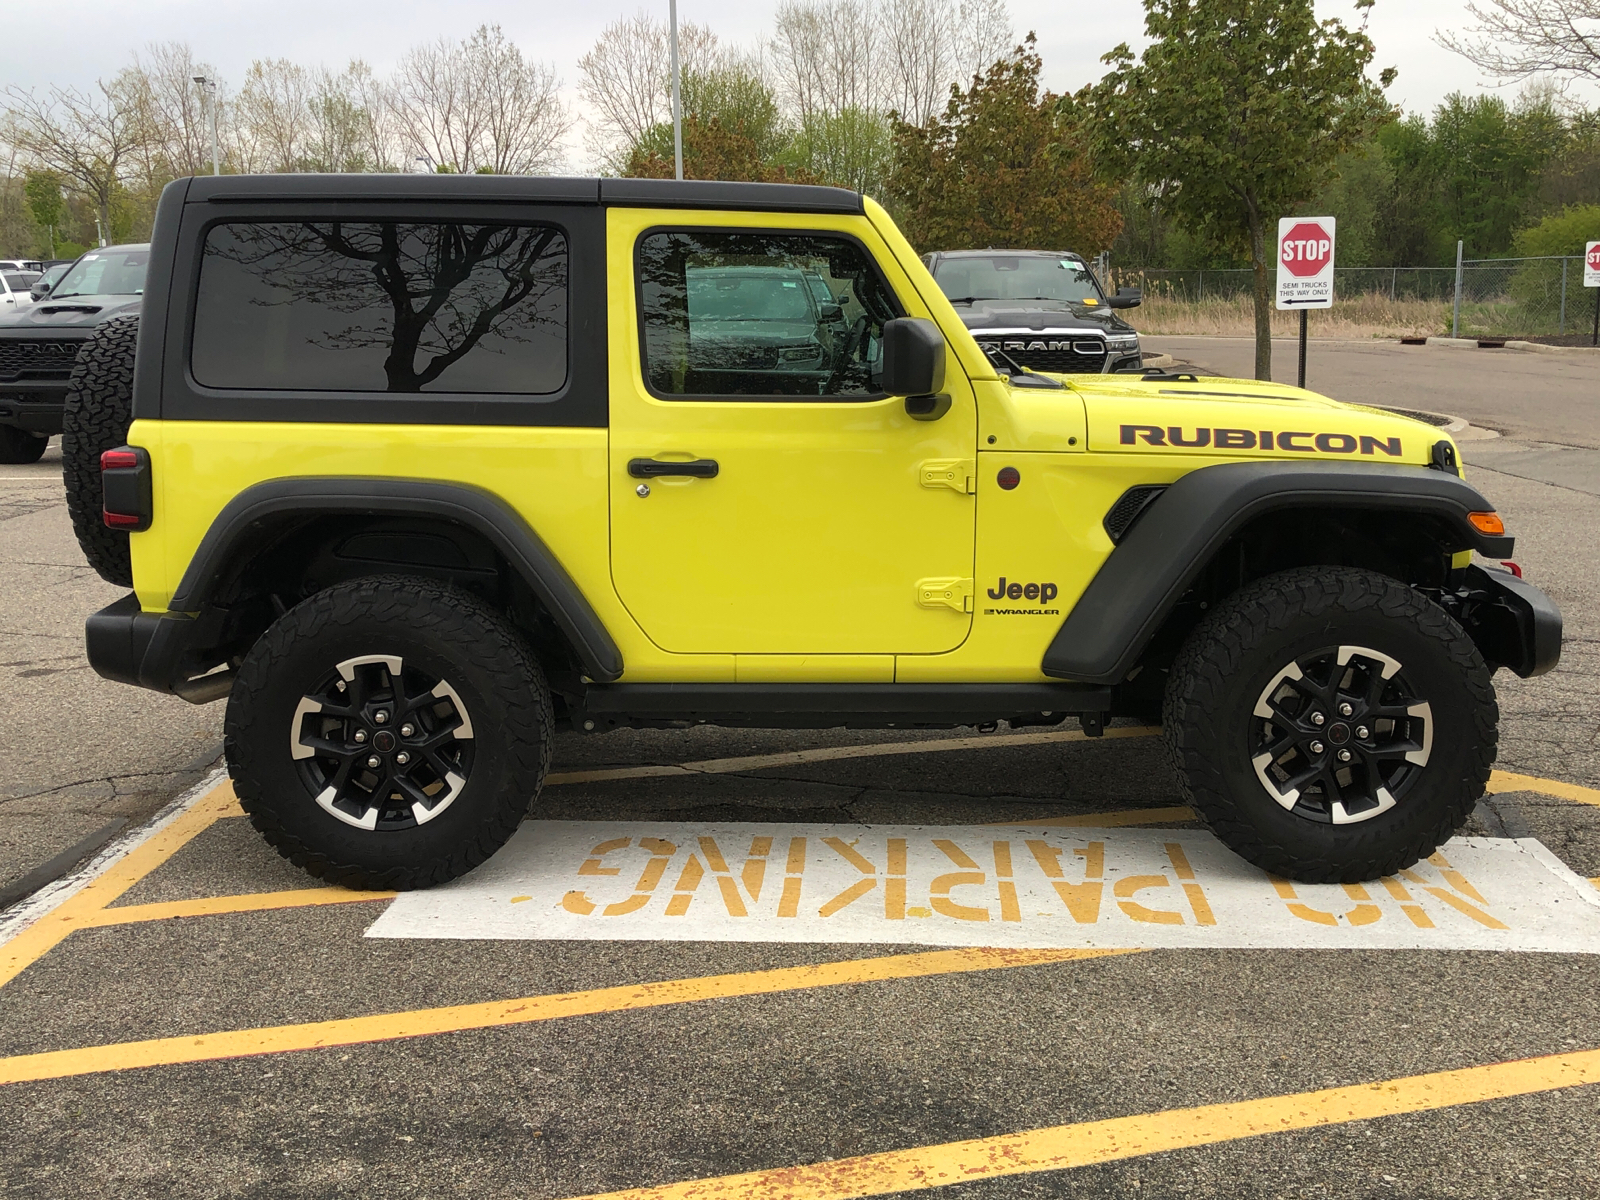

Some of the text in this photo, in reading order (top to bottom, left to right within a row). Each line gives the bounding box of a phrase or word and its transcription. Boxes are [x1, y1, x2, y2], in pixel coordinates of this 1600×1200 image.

[1282, 239, 1330, 261] STOP
[1003, 341, 1071, 351] RAM
[1119, 424, 1403, 457] RUBICON
[987, 577, 1058, 605] Jeep
[995, 608, 1060, 616] WRANGLER
[562, 836, 1218, 927] PARKING
